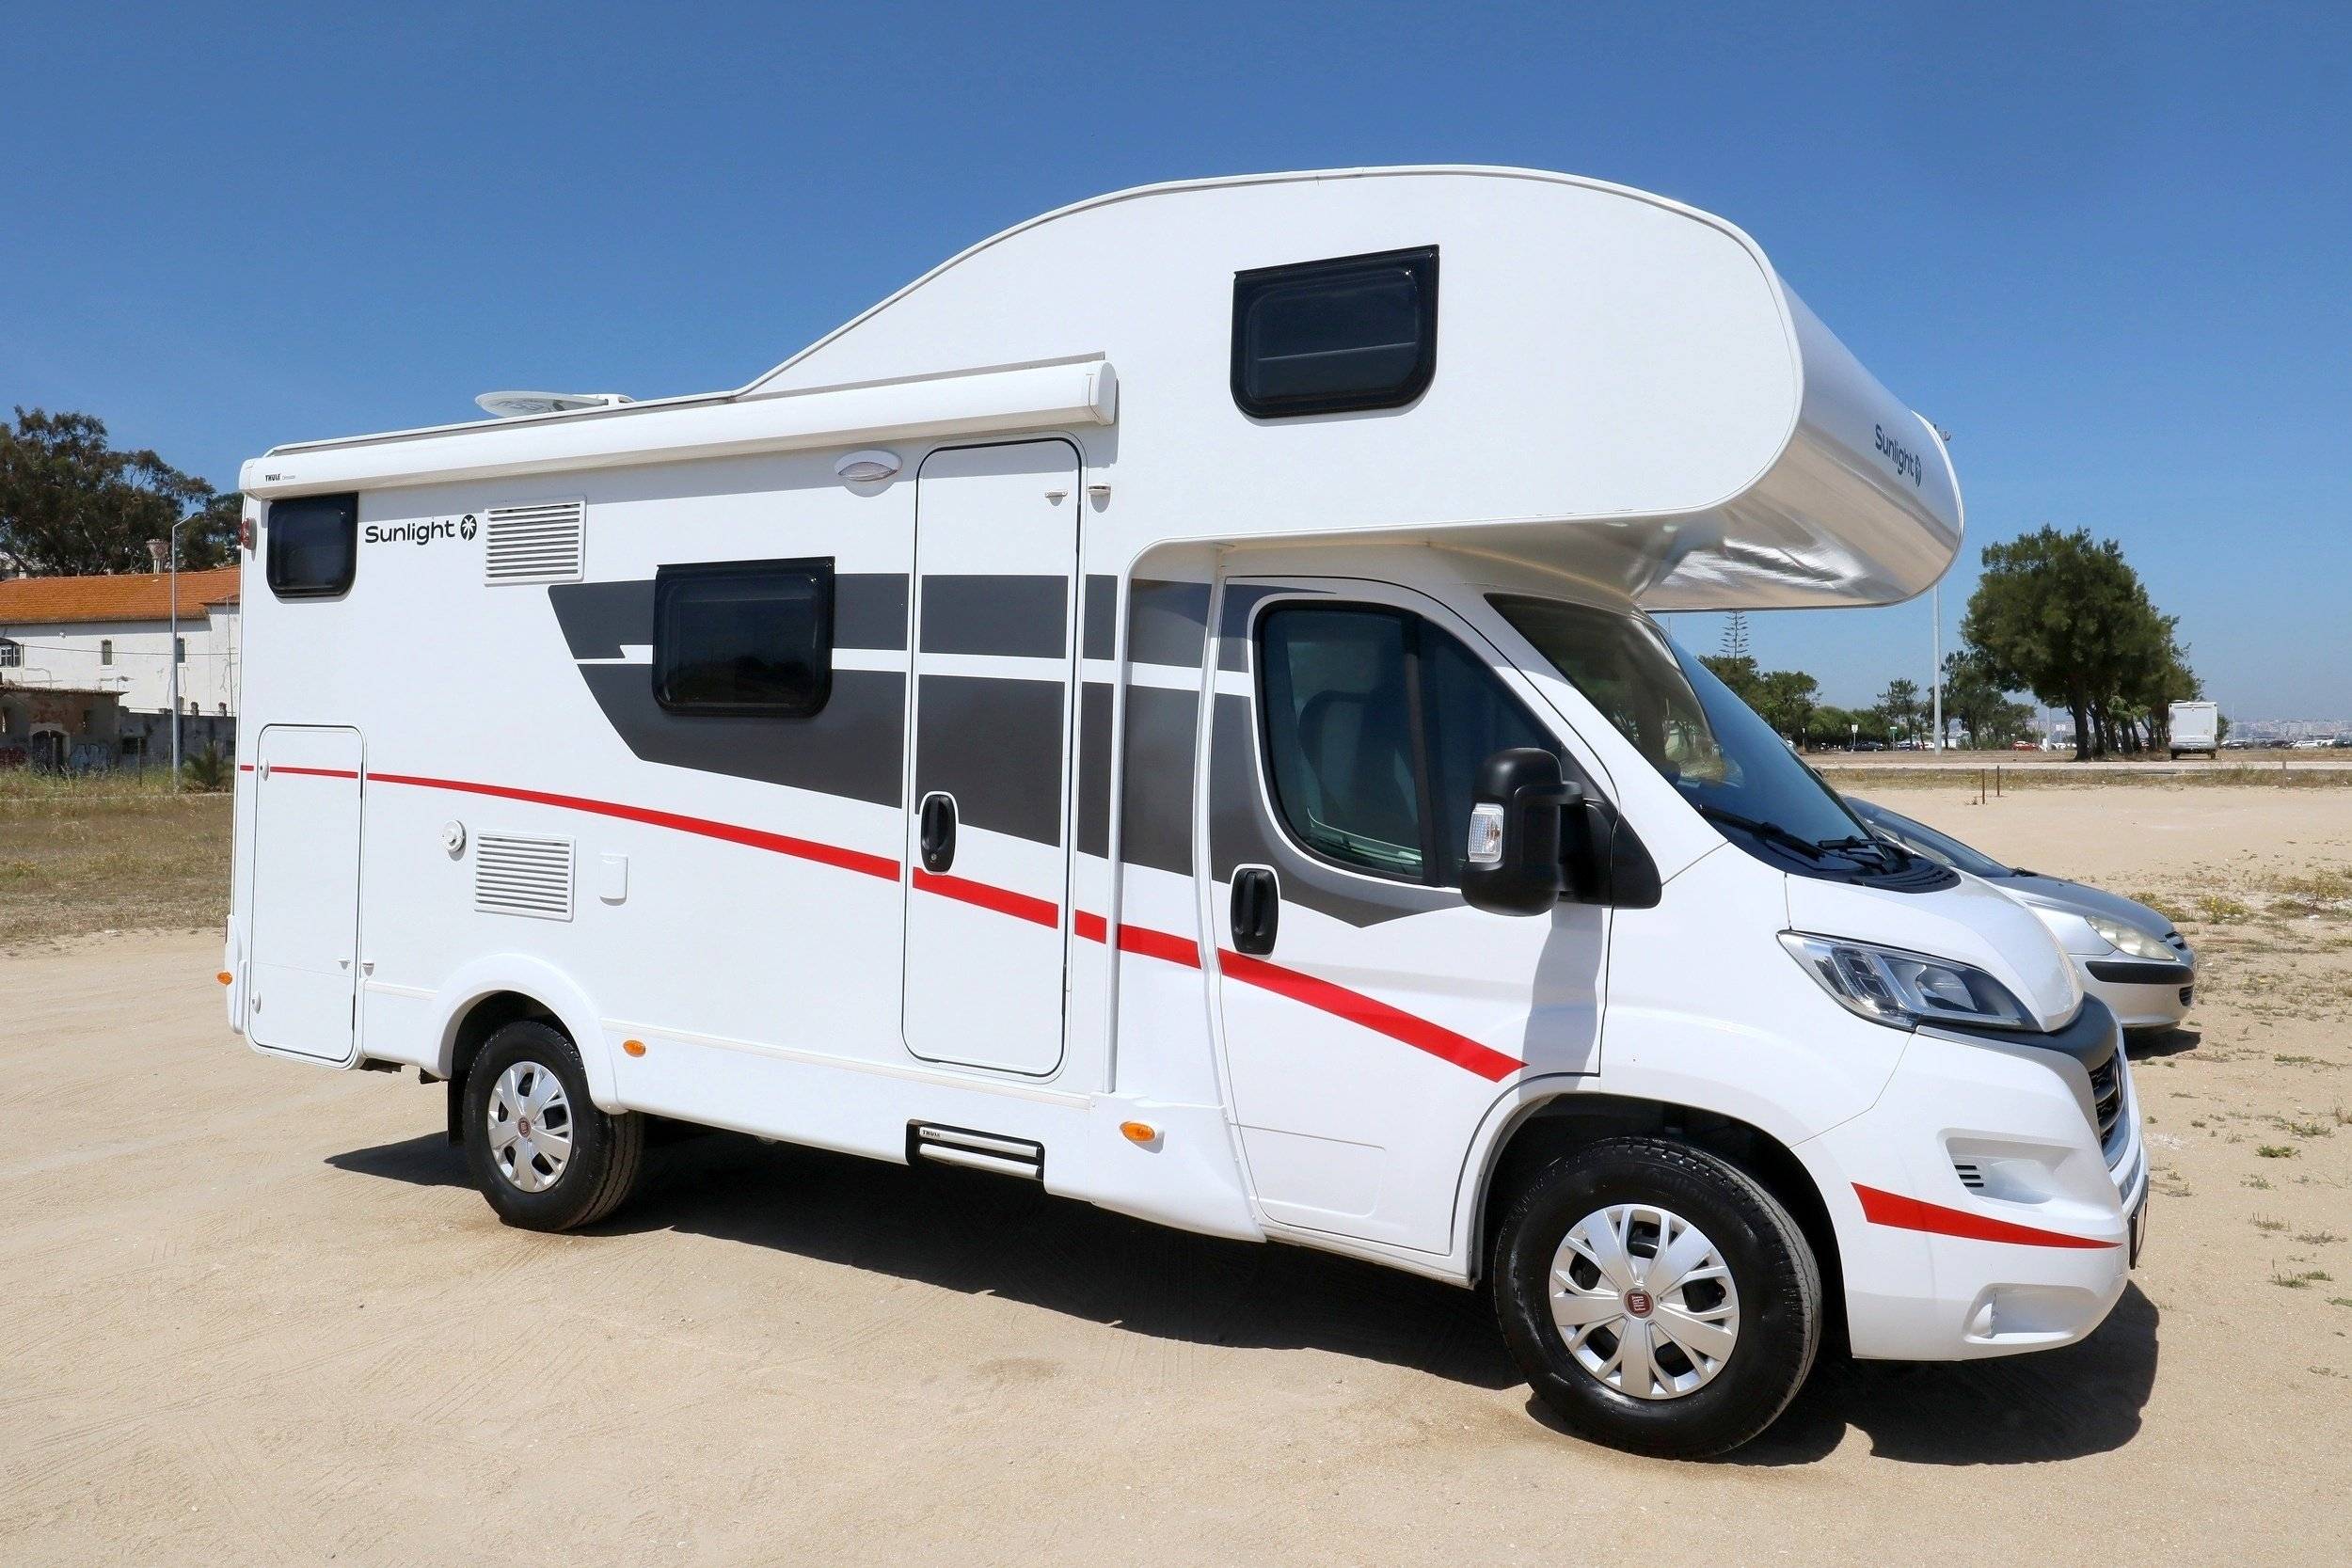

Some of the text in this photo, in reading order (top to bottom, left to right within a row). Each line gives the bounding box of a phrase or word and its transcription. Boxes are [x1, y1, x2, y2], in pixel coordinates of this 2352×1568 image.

[1875, 423, 1915, 477] Sunlight
[365, 520, 456, 546] Sunlight
[1631, 1295, 1646, 1311] FIAT
